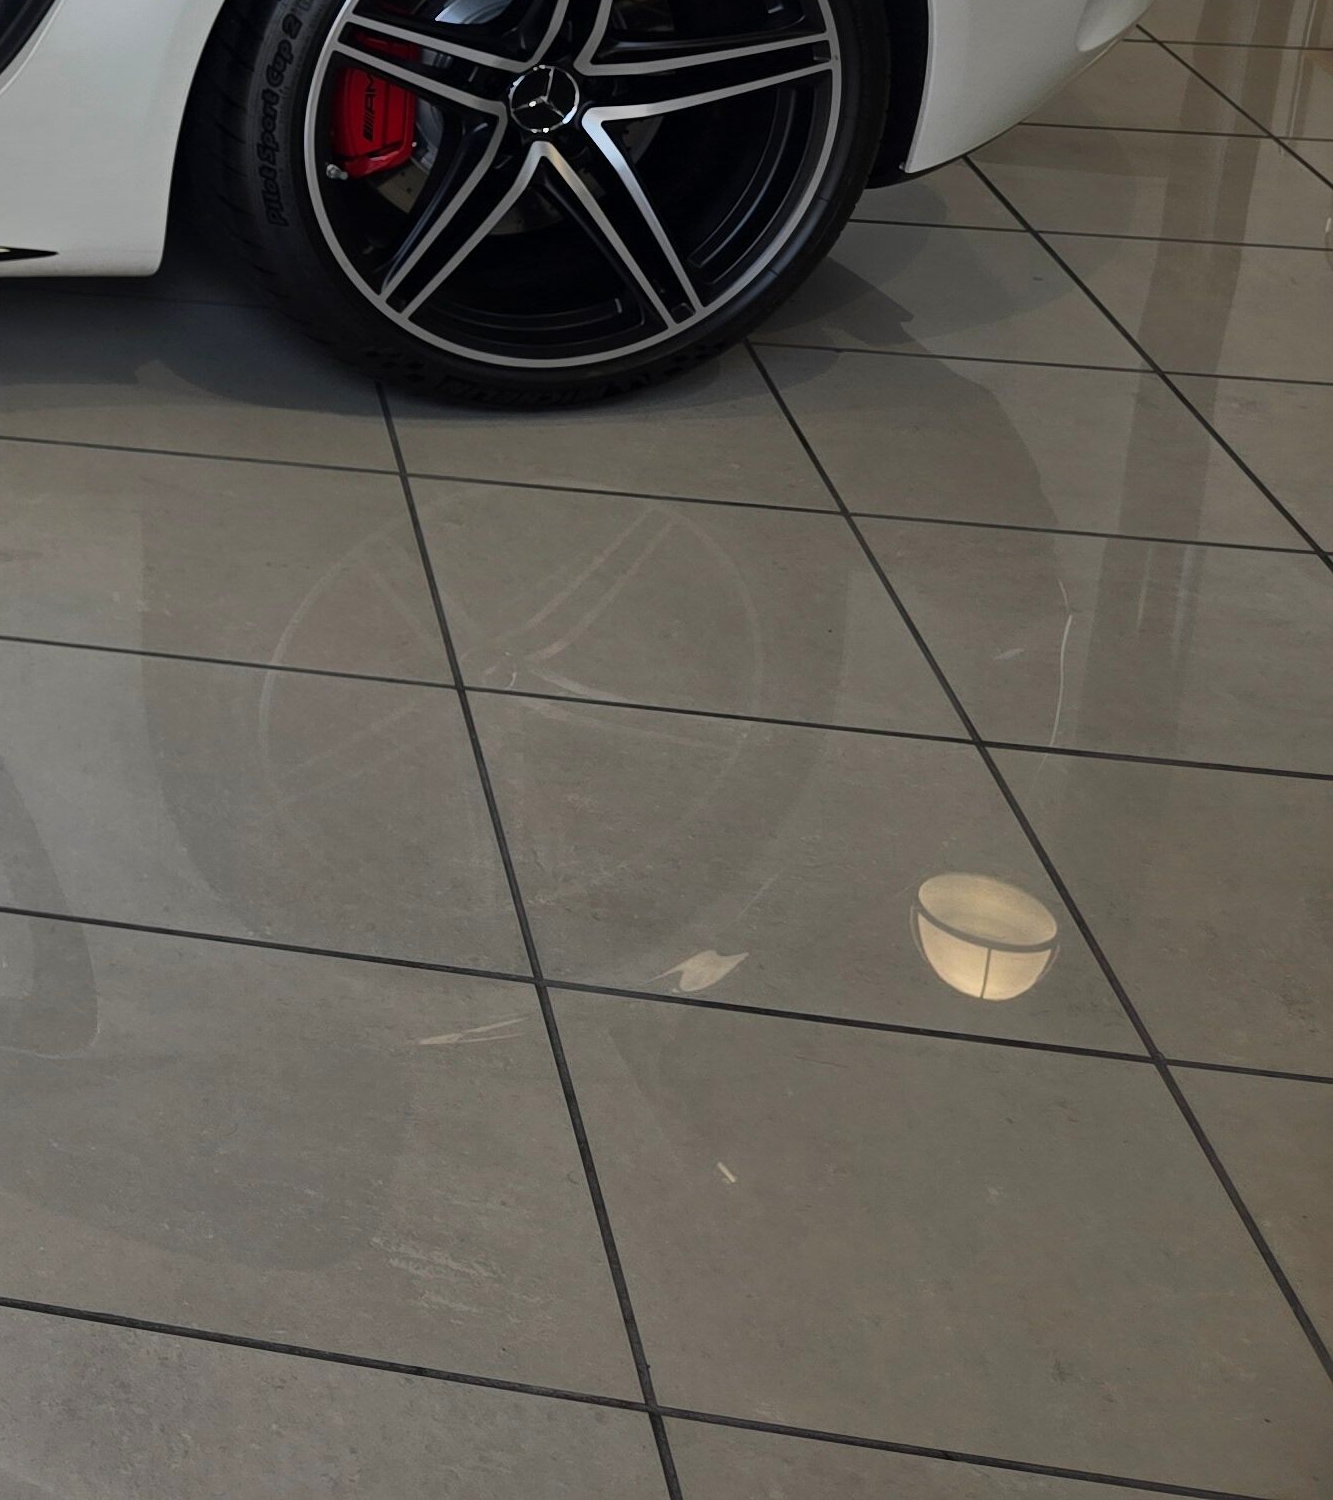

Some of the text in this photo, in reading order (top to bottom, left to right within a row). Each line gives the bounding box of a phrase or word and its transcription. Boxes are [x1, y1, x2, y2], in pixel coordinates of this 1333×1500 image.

[282, 13, 303, 39] 2
[266, 39, 294, 87] Cup
[257, 87, 280, 165] Sport
[258, 165, 289, 227] Pilot
